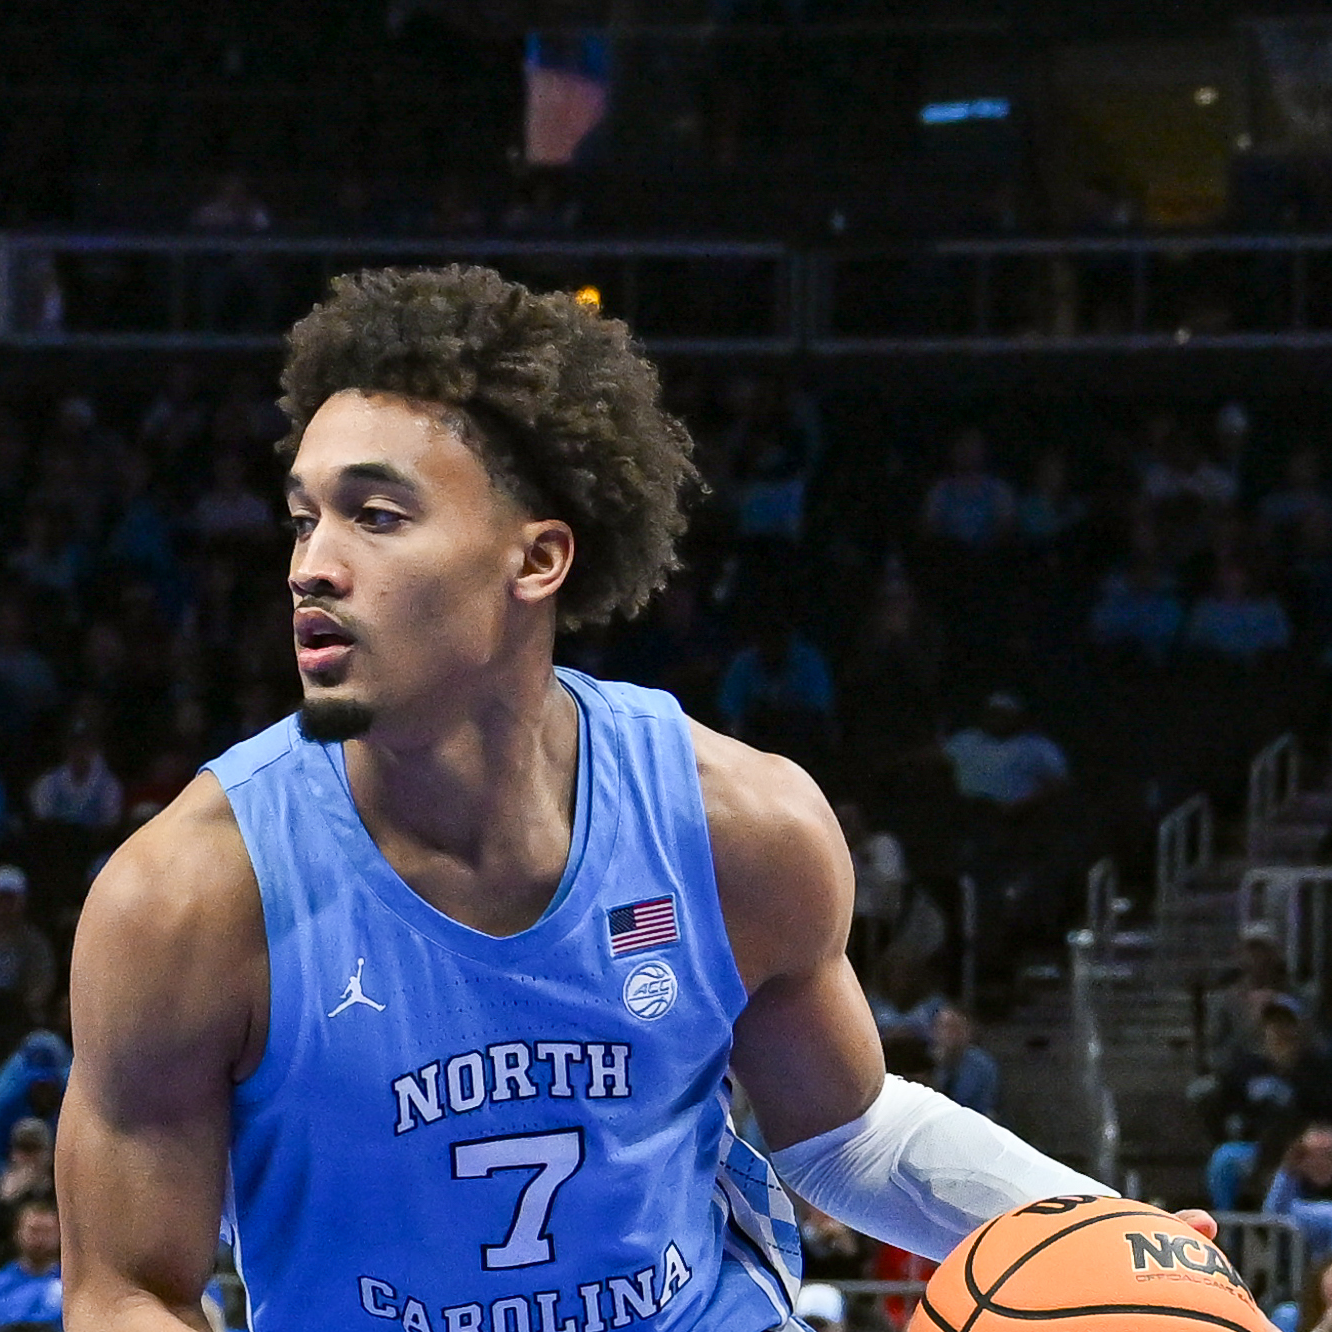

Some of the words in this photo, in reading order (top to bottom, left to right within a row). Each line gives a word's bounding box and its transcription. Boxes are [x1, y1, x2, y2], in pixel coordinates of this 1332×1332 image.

[633, 978, 671, 996] ACC
[393, 1041, 631, 1135] NORTH
[450, 1126, 585, 1271] 7
